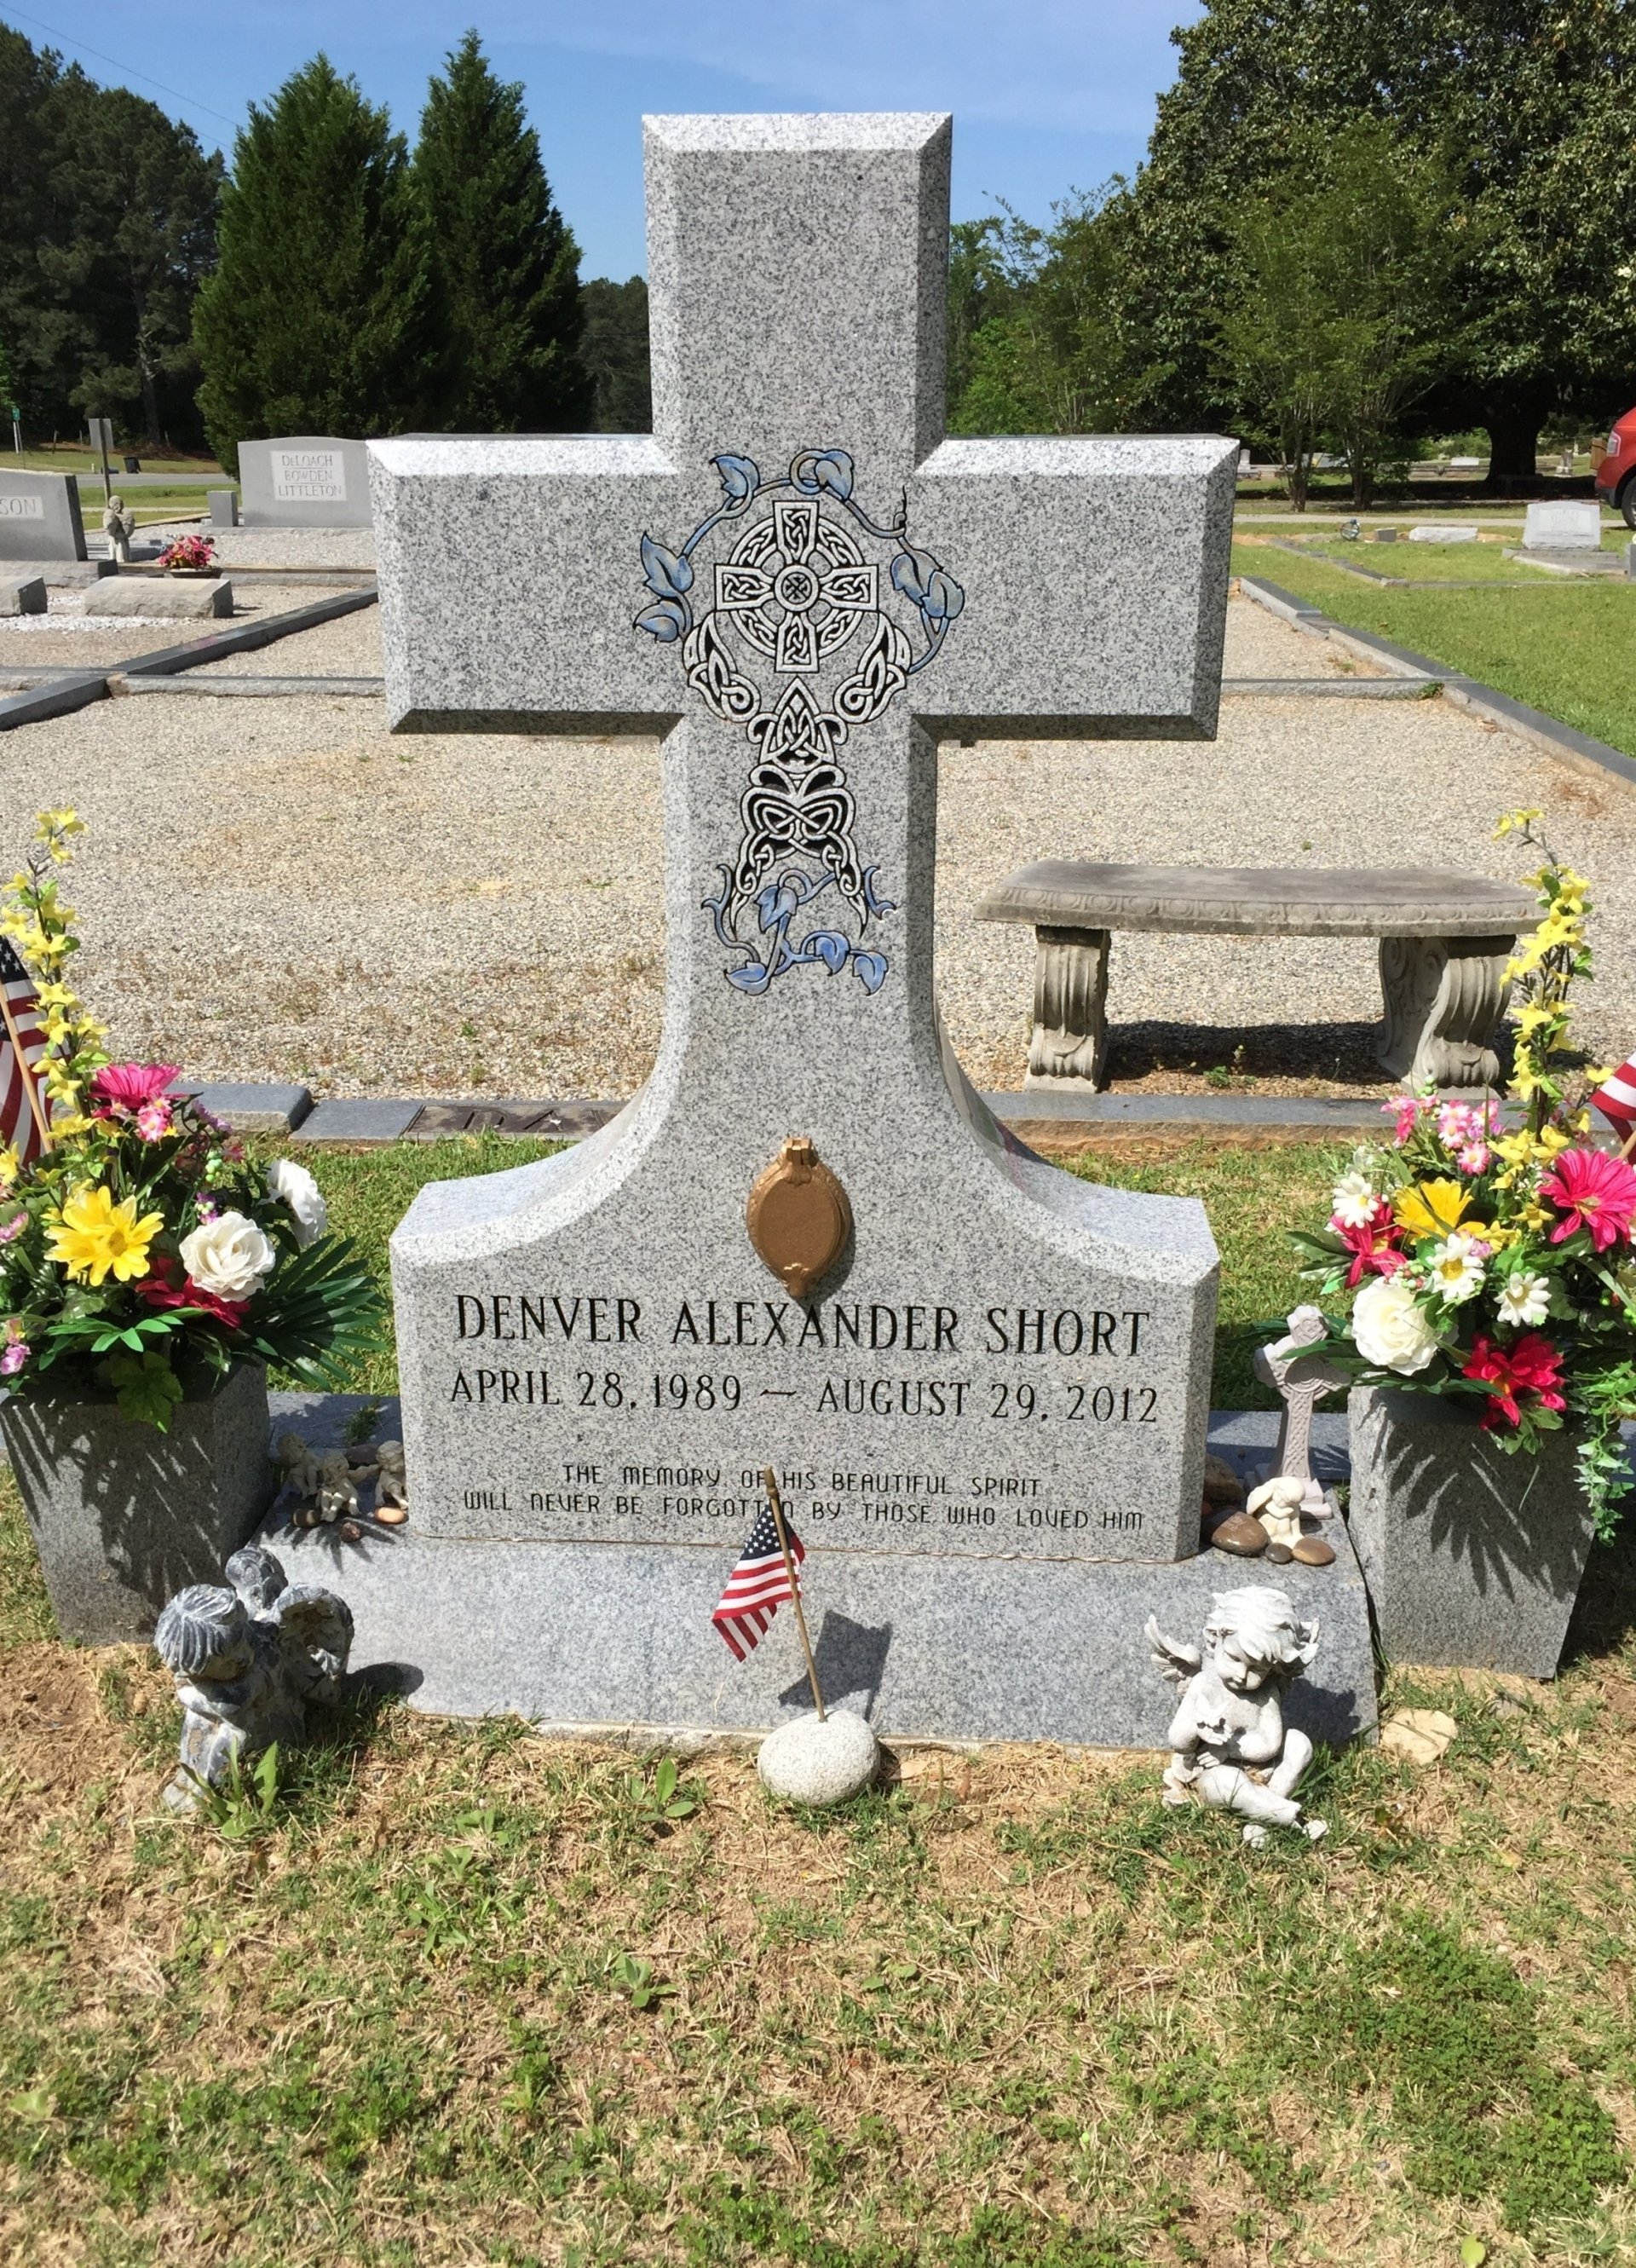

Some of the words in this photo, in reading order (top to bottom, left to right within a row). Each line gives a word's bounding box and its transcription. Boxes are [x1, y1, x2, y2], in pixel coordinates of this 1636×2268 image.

[278, 485, 342, 497] LITTLETON
[284, 470, 333, 482] BOWDEN
[456, 1294, 646, 1344] DENVER
[670, 1300, 960, 1353] ALEXANDER
[986, 1307, 1150, 1358] SHORT
[451, 1369, 560, 1405] APRIL
[653, 1373, 741, 1411] 1989
[816, 1379, 971, 1417] AUGUST
[1066, 1385, 1157, 1423] 2012
[562, 1464, 603, 1485] THE
[623, 1466, 721, 1487] MEMORY
[740, 1469, 765, 1489] OF
[782, 1472, 816, 1491] HIS
[832, 1473, 952, 1496] BEAUTIFUL
[971, 1477, 1042, 1498] SPIRIT
[464, 1492, 513, 1511] WILL
[530, 1493, 601, 1514] NEVER
[616, 1496, 642, 1515] BE
[663, 1497, 794, 1519] FORGOTTN
[812, 1501, 841, 1521] BY
[861, 1503, 932, 1524] THOSE
[948, 1506, 996, 1526] WHO
[1017, 1508, 1089, 1529] LOVED
[1103, 1511, 1143, 1531] HIM
